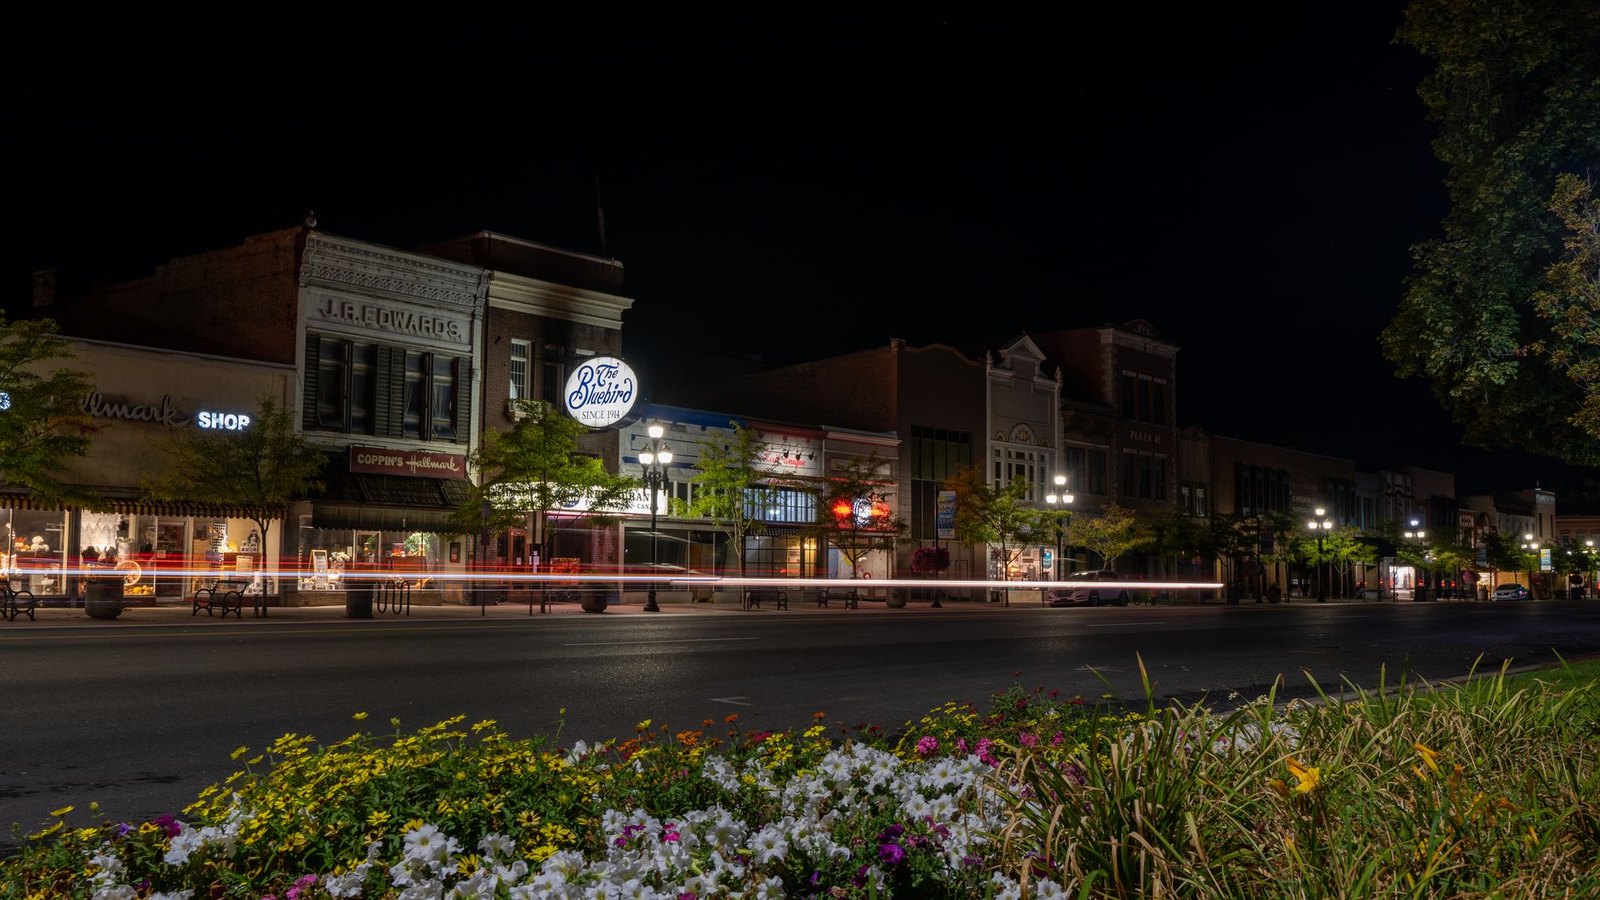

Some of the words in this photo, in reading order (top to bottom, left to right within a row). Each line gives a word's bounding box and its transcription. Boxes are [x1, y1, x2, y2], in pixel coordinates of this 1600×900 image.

[596, 362, 620, 387] The
[569, 365, 633, 409] Bluebird
[198, 411, 251, 431] SHOP
[582, 410, 606, 420] SINCE
[607, 409, 620, 419] 1914
[357, 454, 404, 467] COPPIN'S
[405, 454, 460, 475] Hallmark
